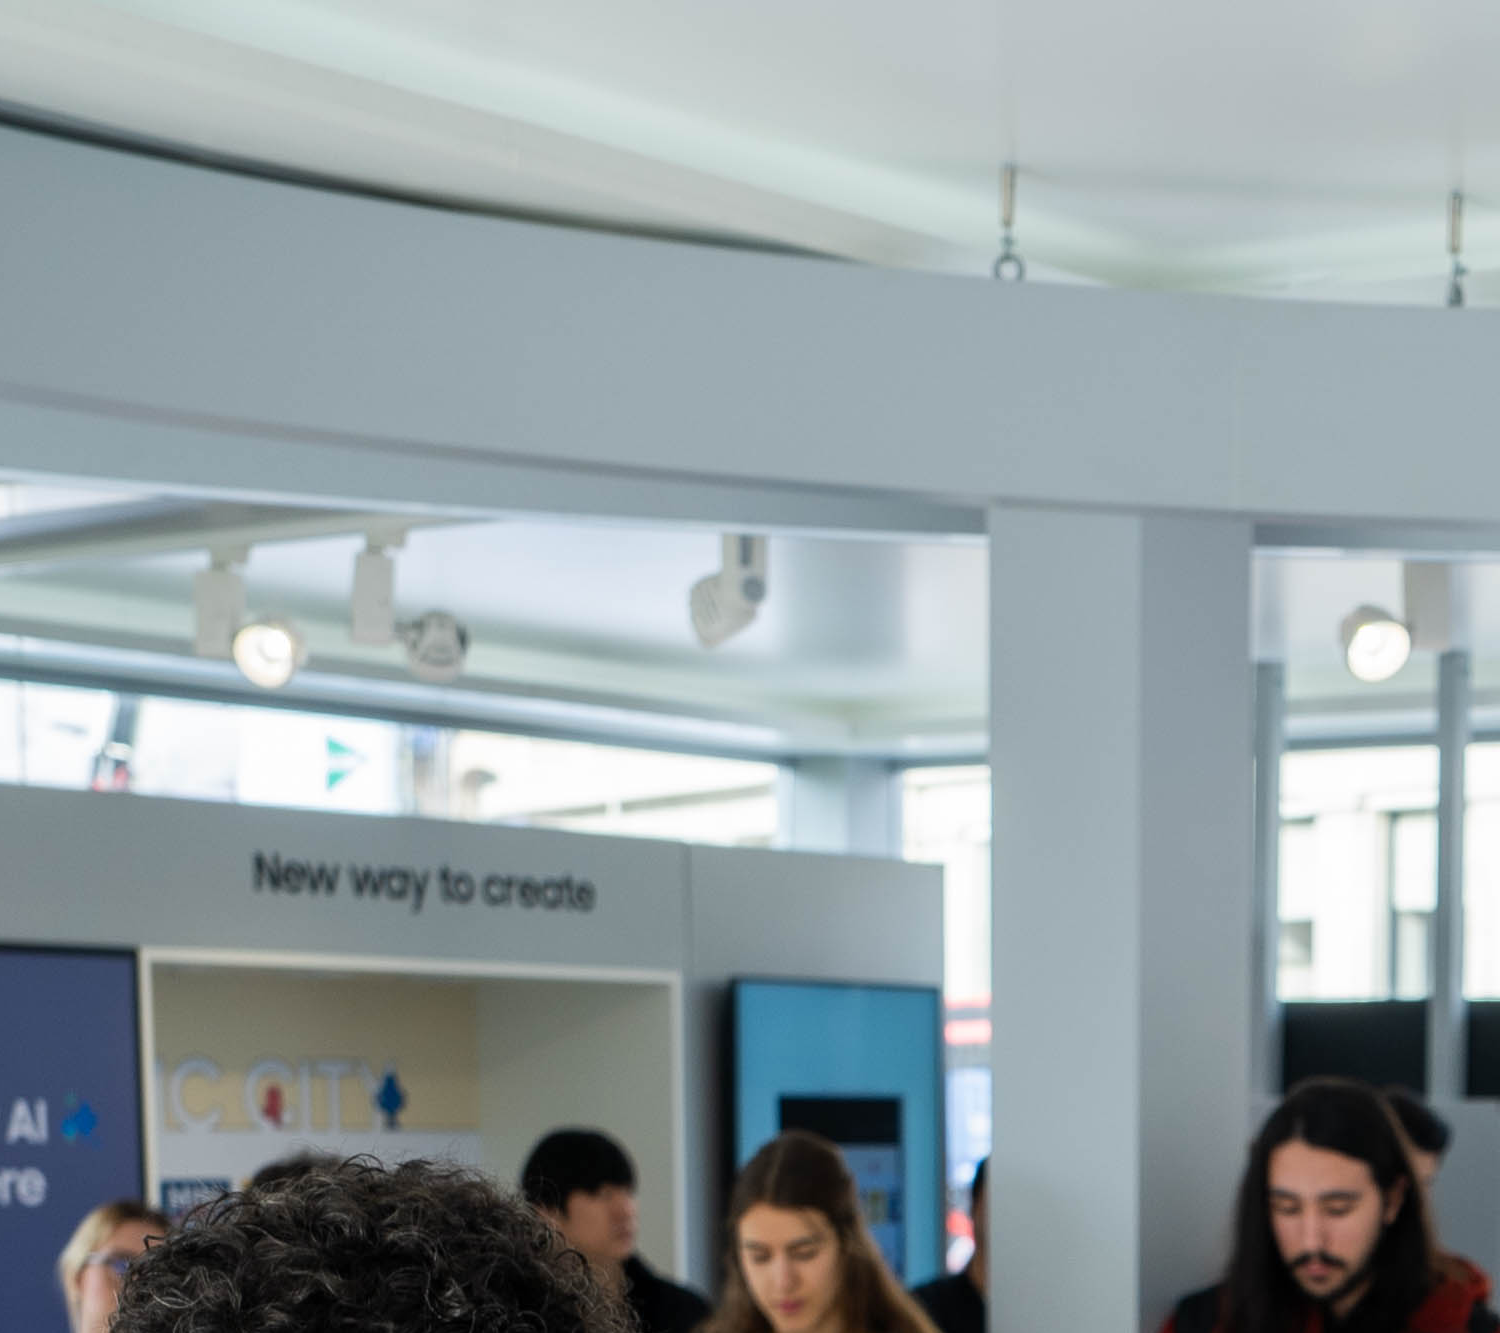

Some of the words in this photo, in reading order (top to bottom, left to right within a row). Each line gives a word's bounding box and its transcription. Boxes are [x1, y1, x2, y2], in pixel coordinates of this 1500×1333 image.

[252, 849, 340, 896] New
[350, 861, 429, 914] way
[438, 859, 476, 905] to
[482, 871, 596, 913] create
[6, 1096, 48, 1145] AI
